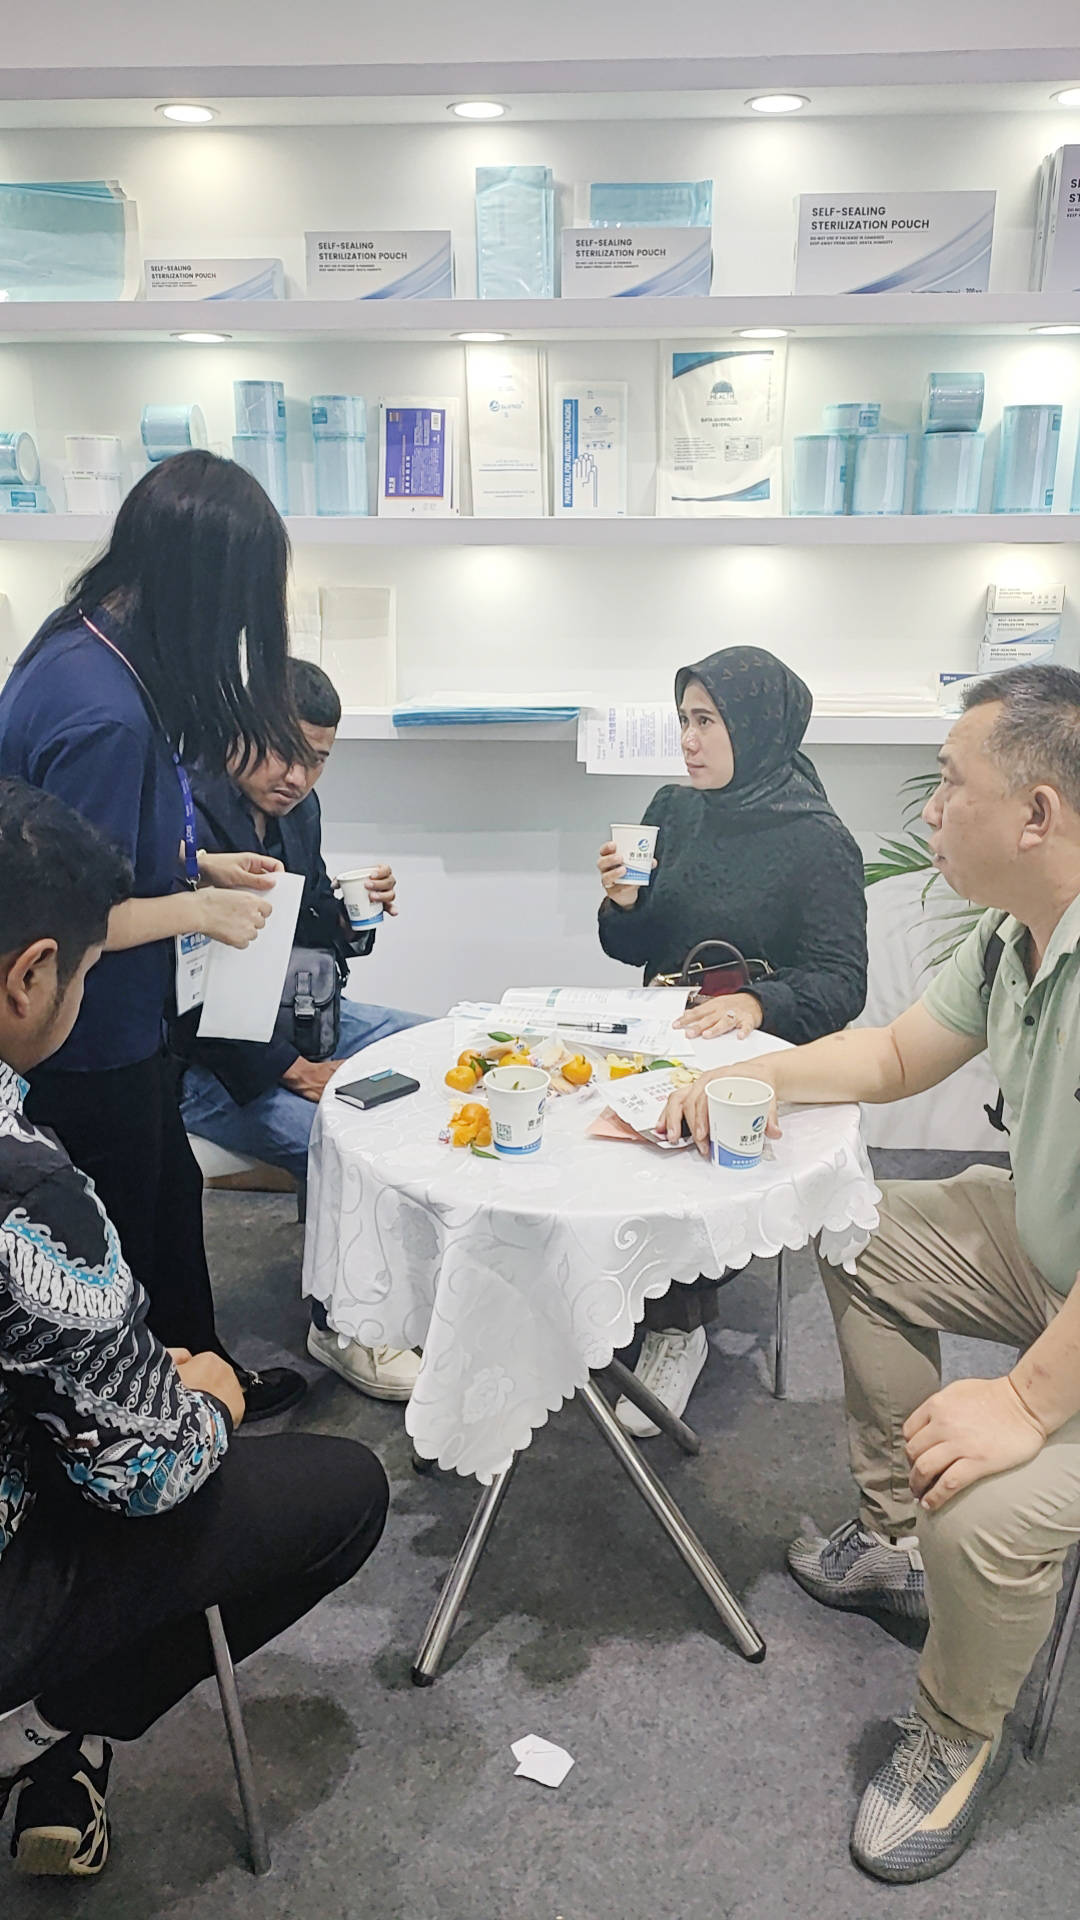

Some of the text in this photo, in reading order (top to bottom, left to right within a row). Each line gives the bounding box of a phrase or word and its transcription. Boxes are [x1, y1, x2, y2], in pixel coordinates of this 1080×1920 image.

[812, 206, 886, 217] SELF-SEALING
[811, 219, 930, 231] STERILIZATION POUCH
[318, 242, 374, 250] SELF-SEALING
[575, 239, 633, 247] SELF-SEALING
[318, 252, 408, 260] STERILIZATION POUCH
[575, 248, 666, 257] STERILIZATION POUCH
